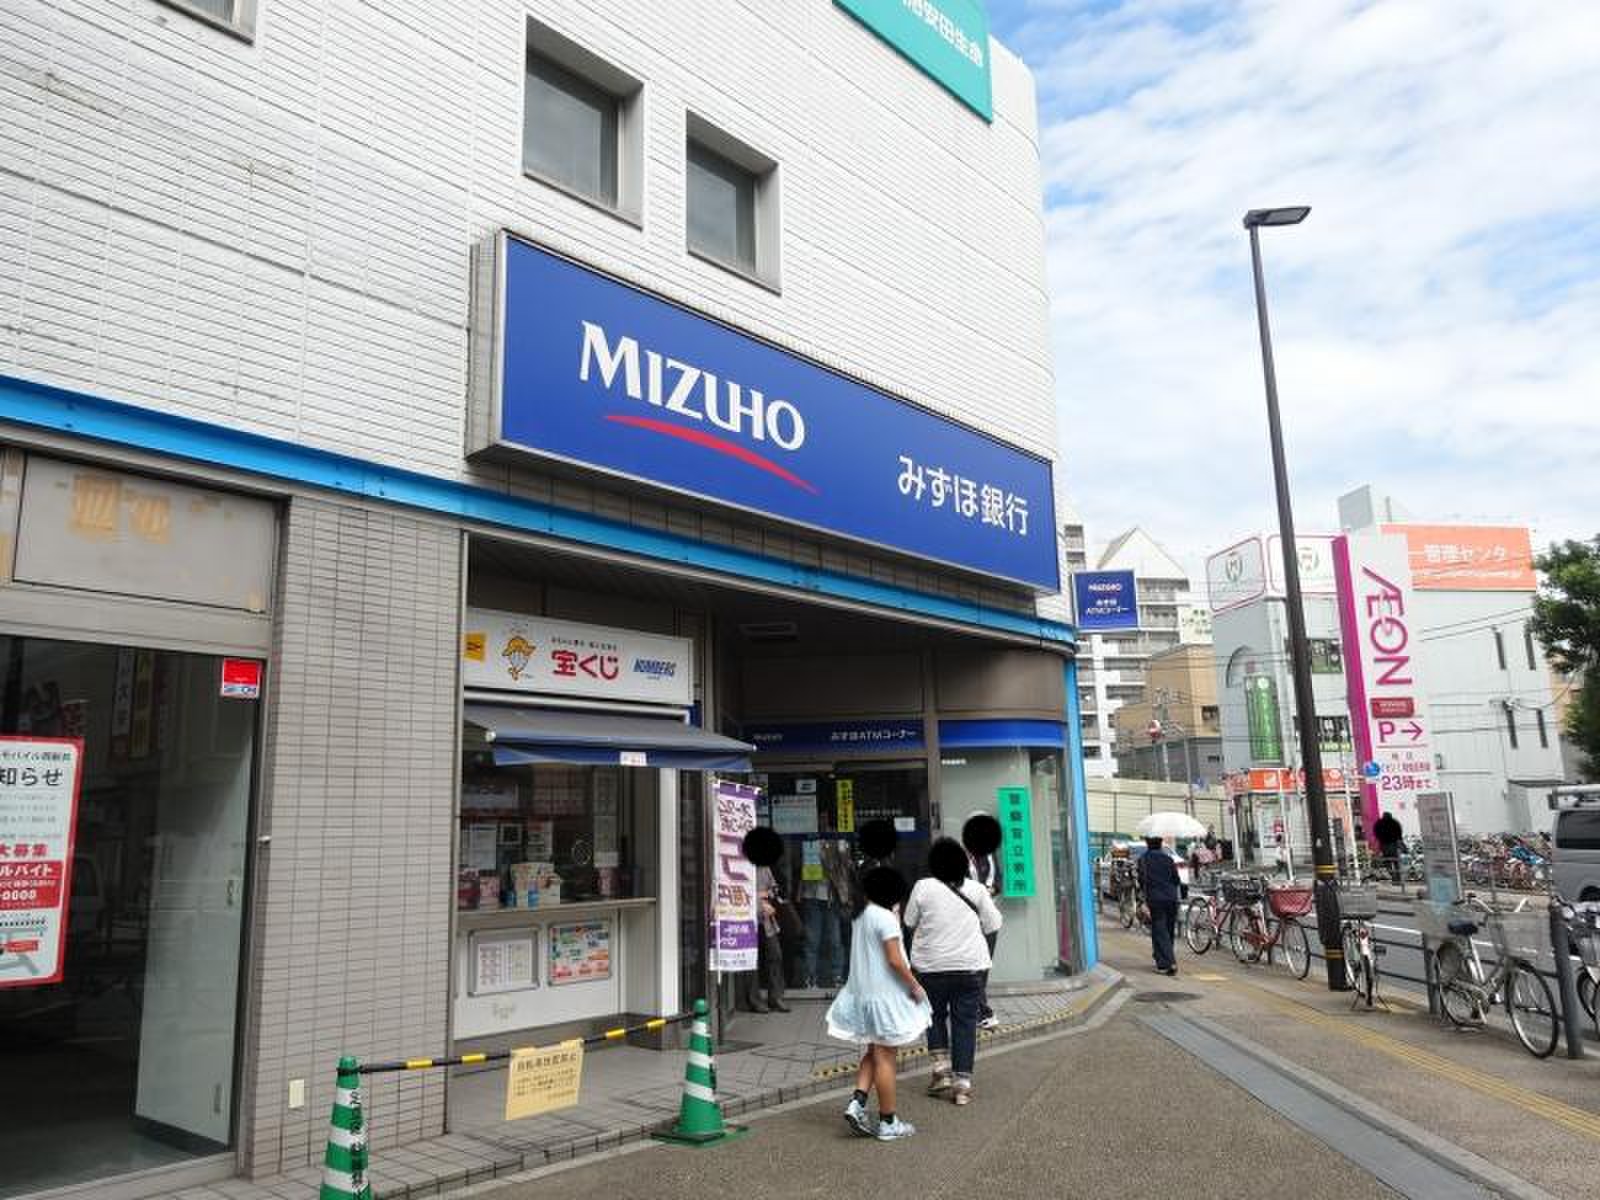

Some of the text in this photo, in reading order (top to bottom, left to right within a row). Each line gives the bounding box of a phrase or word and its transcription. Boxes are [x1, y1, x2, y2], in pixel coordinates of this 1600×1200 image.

[901, 0, 984, 67] 治安田生命
[580, 320, 806, 451] MIZUHO
[897, 455, 1029, 537] みずほ銀行
[1361, 565, 1413, 686] AEON
[551, 649, 620, 681] 宝くじ
[1378, 720, 1396, 743] P
